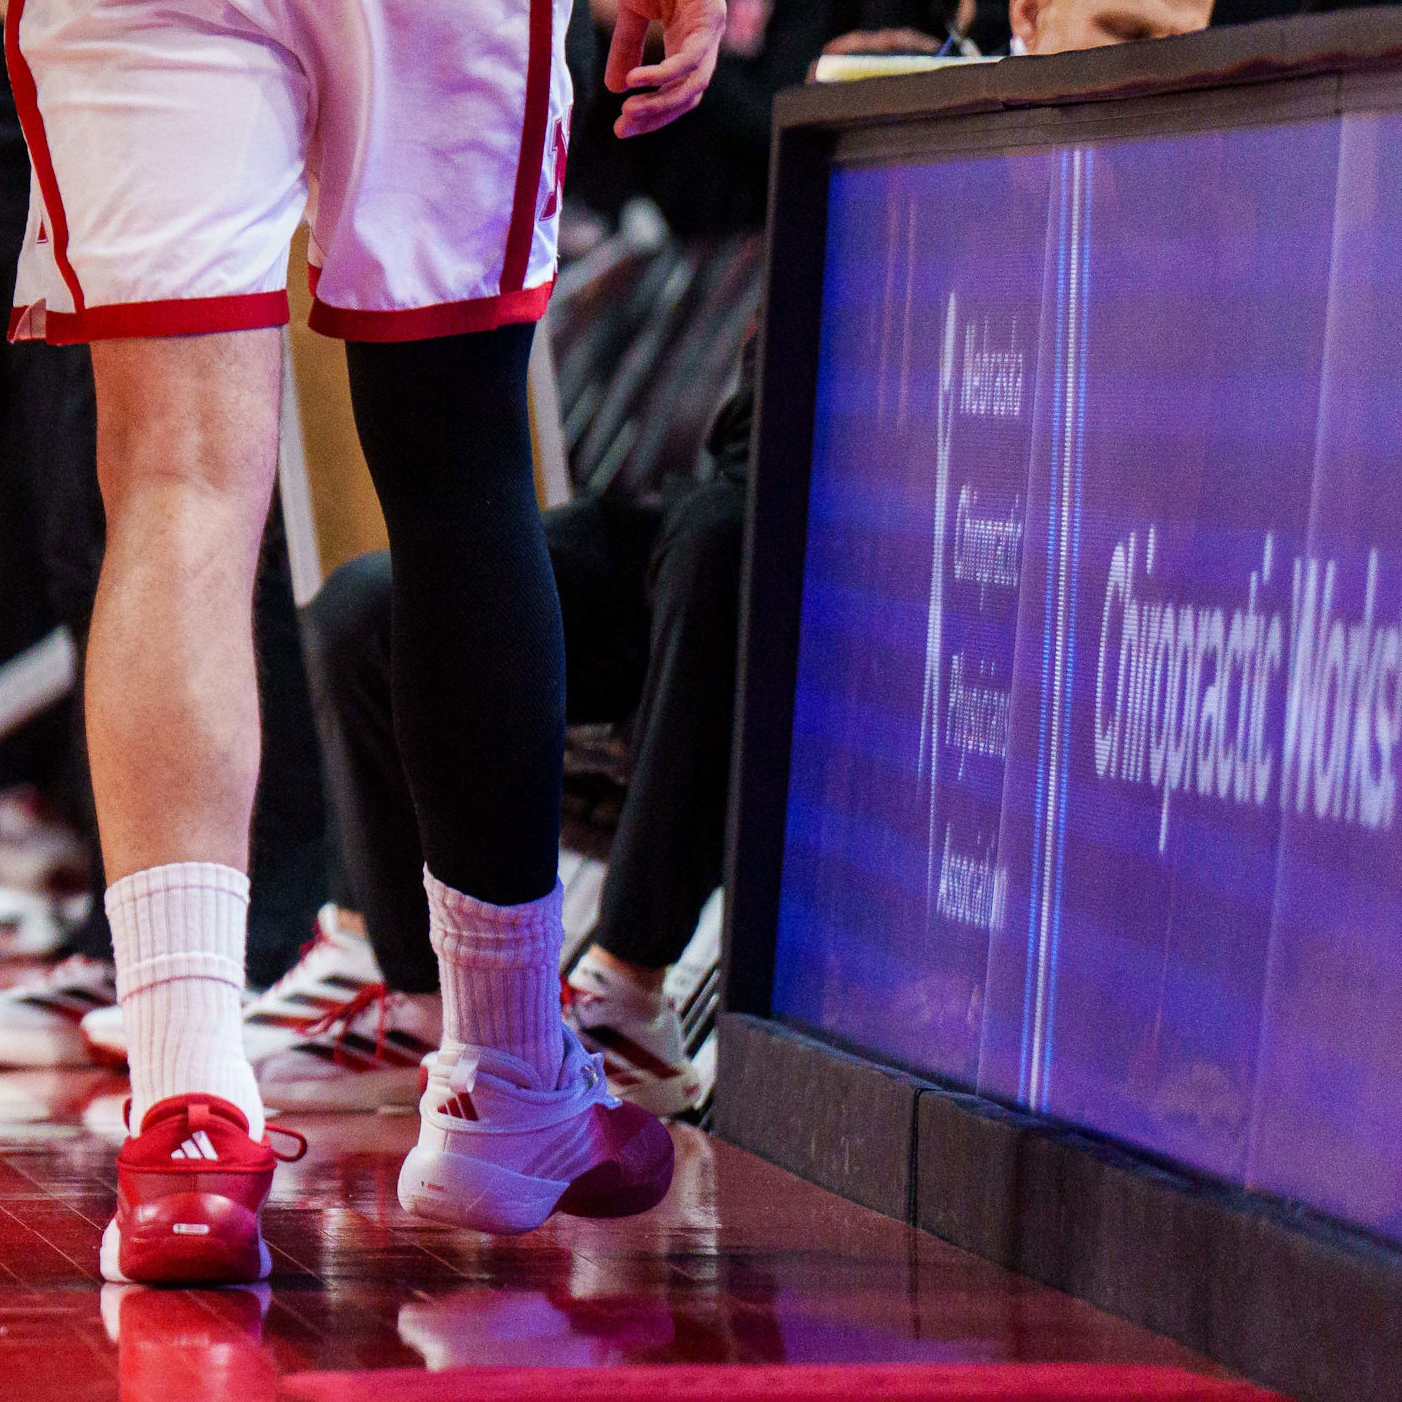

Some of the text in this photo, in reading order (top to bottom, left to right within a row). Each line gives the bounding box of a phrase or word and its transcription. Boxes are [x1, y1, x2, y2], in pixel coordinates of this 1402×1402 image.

[959, 318, 1024, 418] Nebraska
[954, 482, 1024, 612] Chiropractic
[945, 648, 1012, 782] Physicians
[1094, 524, 1282, 854] Chiropractic
[936, 821, 1007, 933] Association
